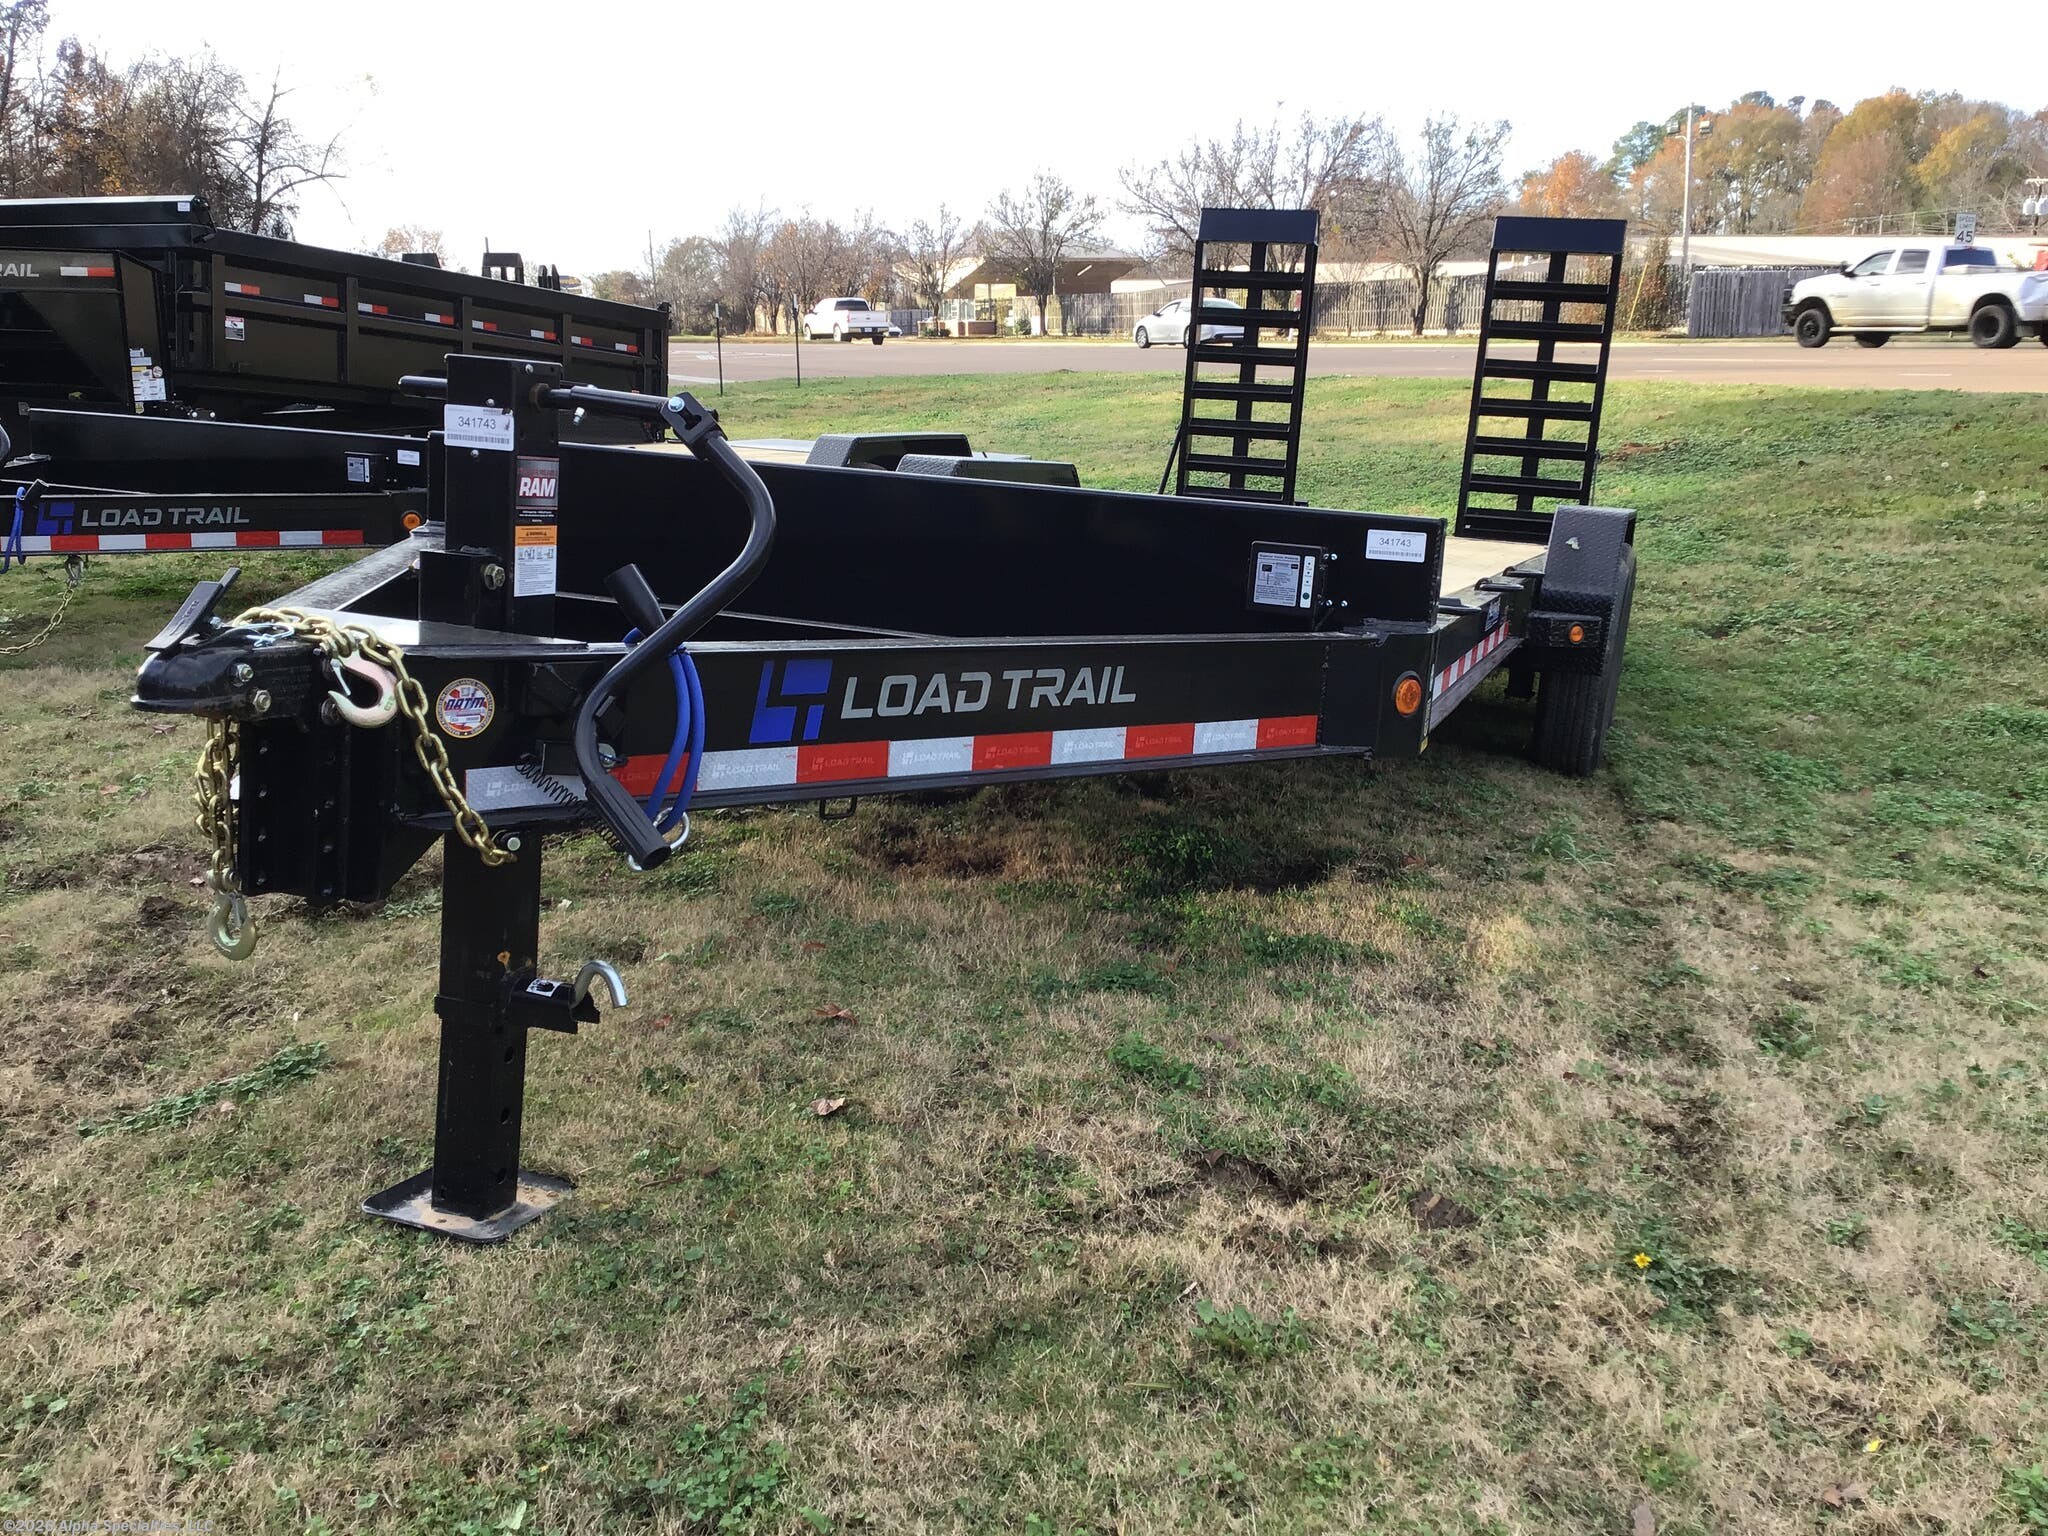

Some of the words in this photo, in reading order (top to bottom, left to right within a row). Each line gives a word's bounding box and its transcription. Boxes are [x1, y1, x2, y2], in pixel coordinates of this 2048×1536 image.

[1957, 231, 1973, 243] 45
[458, 416, 497, 430] 341743
[519, 477, 556, 497] RAM
[81, 508, 162, 528] LOAD
[168, 506, 250, 525] TRAIL
[1378, 536, 1412, 548] 341743
[840, 671, 992, 720] LOAD
[1002, 665, 1137, 710] TRAIL
[825, 759, 850, 767] LOAD
[851, 757, 875, 765] TRAIL
[914, 752, 937, 762] LOAD
[937, 751, 961, 760] TRAIL
[727, 764, 752, 775] LOAD
[753, 763, 781, 773] TRAIL
